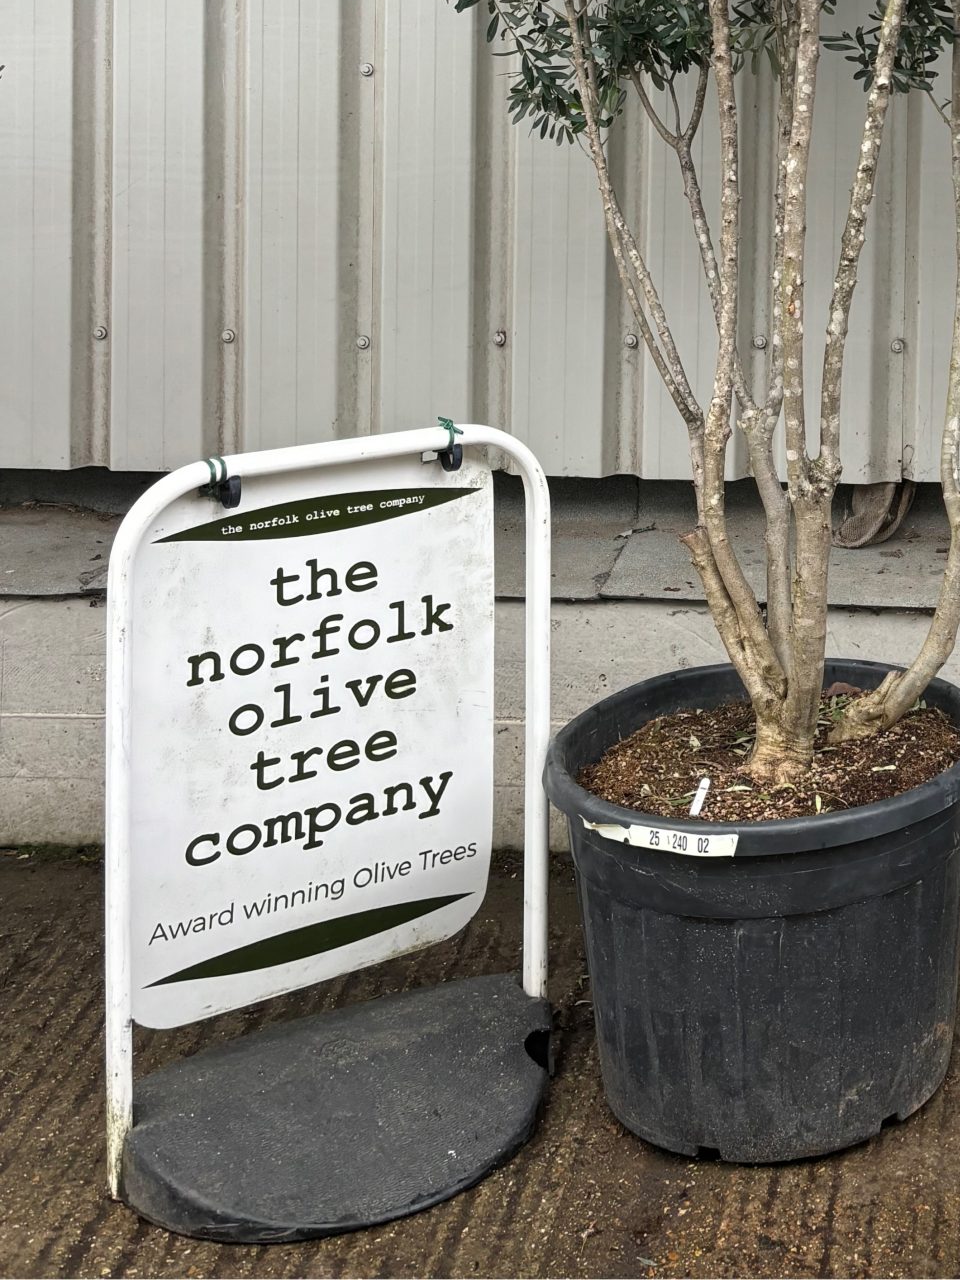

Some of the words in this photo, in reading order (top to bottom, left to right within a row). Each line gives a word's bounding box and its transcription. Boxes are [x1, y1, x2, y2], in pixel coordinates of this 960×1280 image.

[221, 524, 243, 536] the
[249, 514, 300, 531] norfolk
[305, 505, 341, 521] olive
[346, 501, 374, 514] tree
[379, 494, 426, 510] company
[270, 559, 378, 606] the
[186, 595, 454, 687] norfolk
[228, 668, 417, 736] olive
[250, 730, 398, 791] tree
[185, 771, 453, 866] company
[649, 830, 660, 846] 25
[672, 834, 687, 851] 240
[697, 837, 709, 853] 02
[148, 904, 234, 945] Award
[243, 878, 345, 918] winning
[353, 862, 412, 889] Olive
[419, 841, 477, 872] Trees
